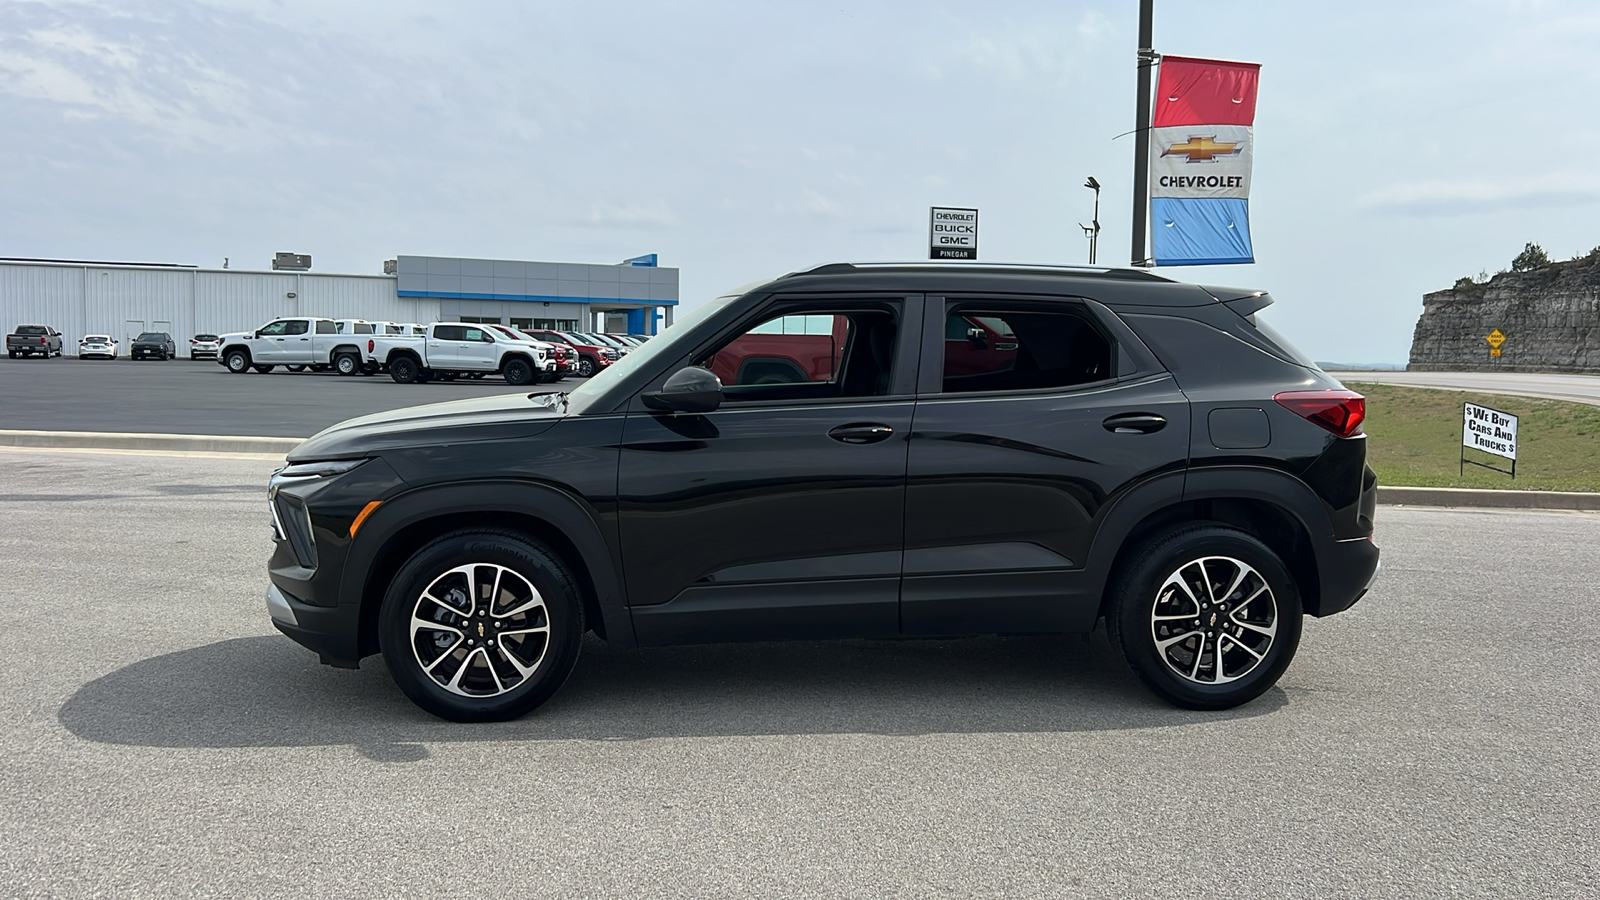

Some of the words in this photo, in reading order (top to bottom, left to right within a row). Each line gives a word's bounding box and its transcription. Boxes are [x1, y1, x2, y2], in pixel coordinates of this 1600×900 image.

[1159, 175, 1243, 188] CHEVROLET
[936, 212, 974, 221] CHEVROLET
[935, 224, 974, 233] BUICK
[940, 236, 969, 245] GMC
[940, 250, 968, 258] PINEGAR
